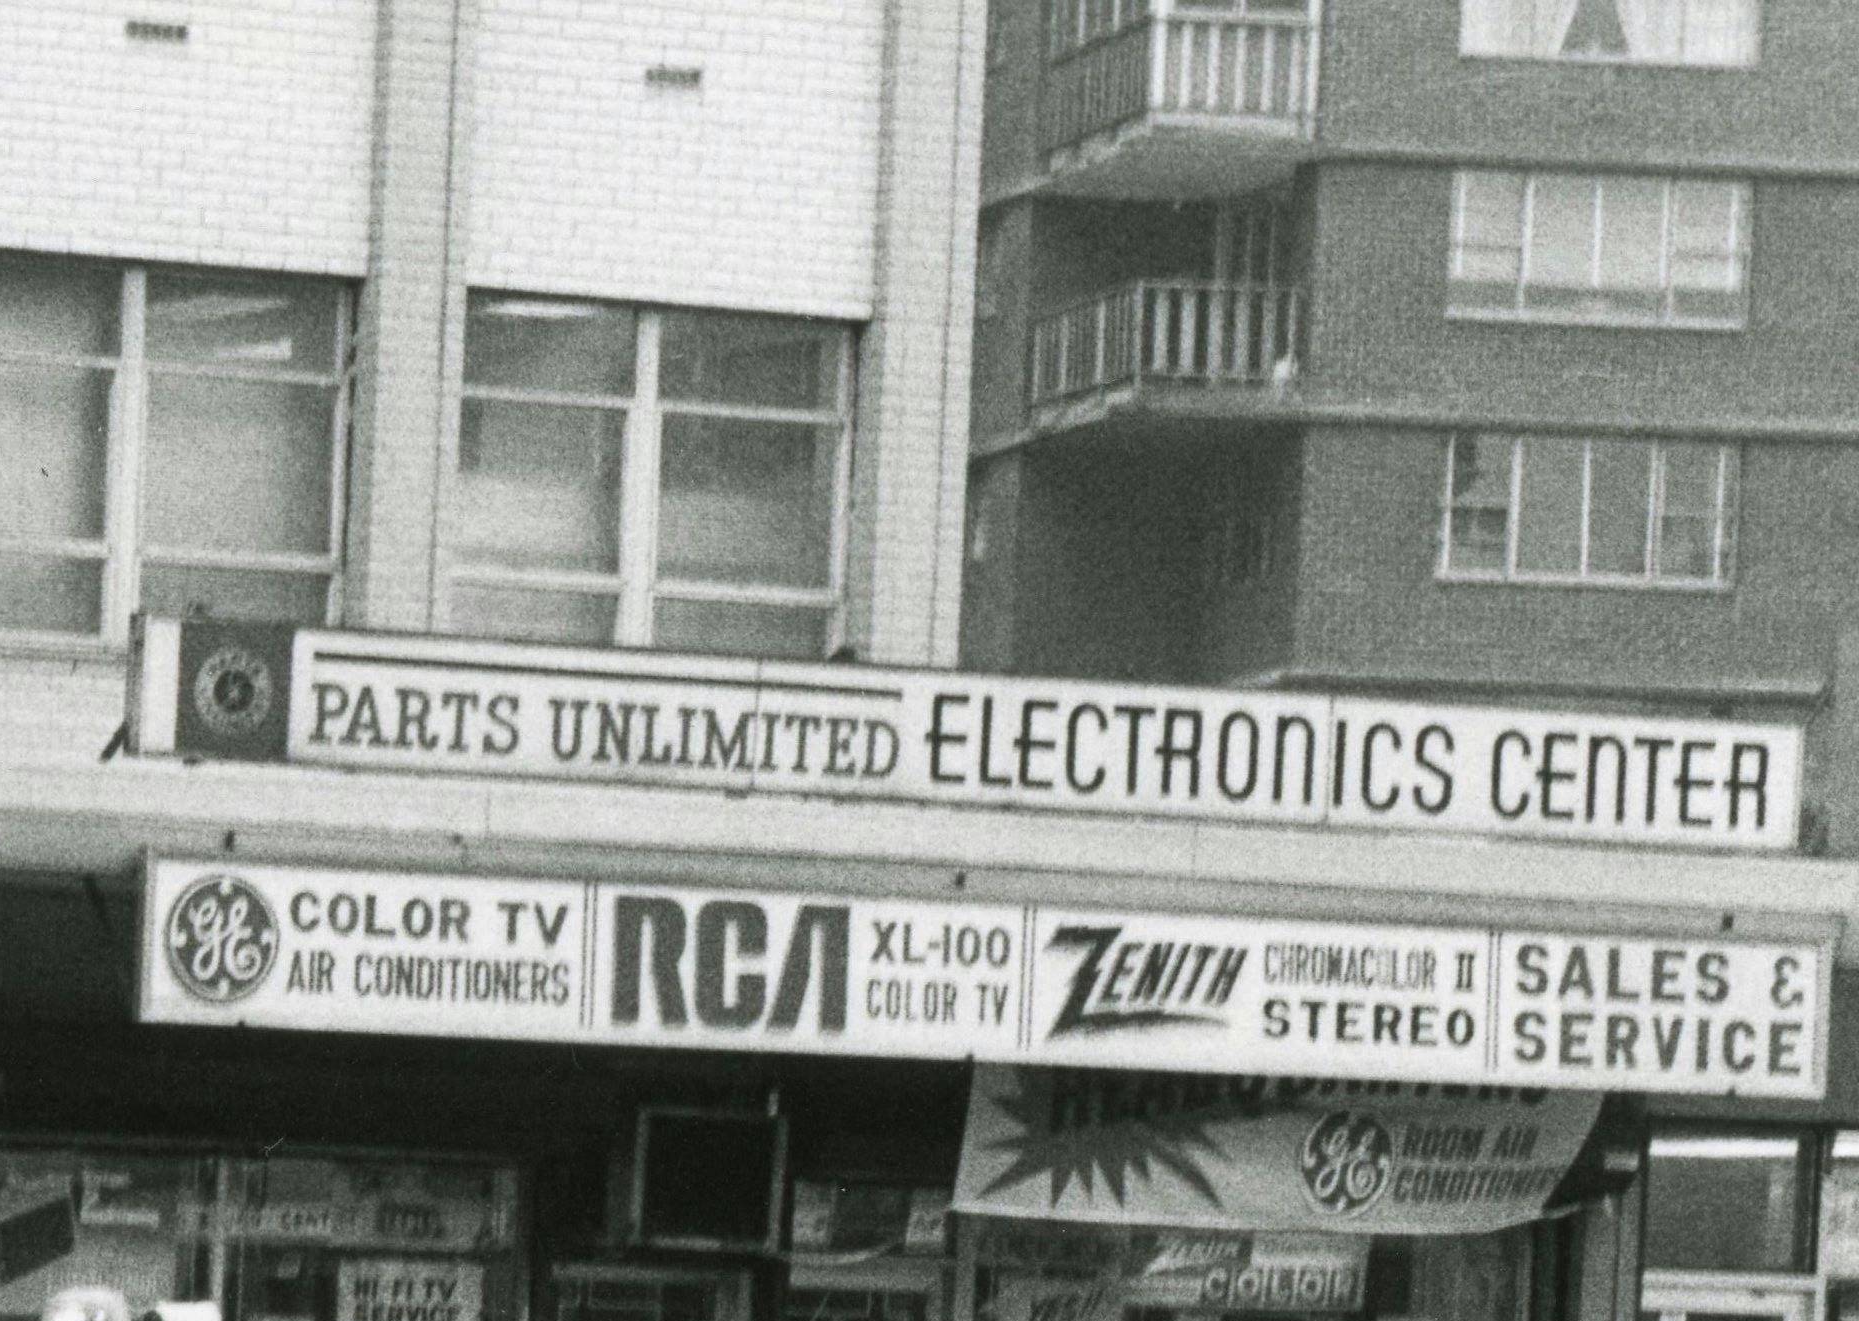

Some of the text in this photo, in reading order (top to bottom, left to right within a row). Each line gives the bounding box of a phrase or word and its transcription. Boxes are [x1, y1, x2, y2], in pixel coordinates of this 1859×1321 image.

[306, 682, 521, 755] PARTS
[547, 698, 902, 779] UNLIMITED
[925, 690, 1456, 815] ELECTRONICS
[1490, 729, 1772, 831] CENTER
[289, 892, 570, 946] COLOR TV
[870, 920, 1011, 968] XL-100
[285, 951, 570, 1006] AIR CONDITIONERS
[613, 894, 852, 1031] RCA
[1043, 924, 1250, 1040] ZENITH
[1264, 943, 1476, 992] CHROMACOLOR II
[1515, 943, 1805, 1010] SALES &
[866, 977, 1009, 1026] COLOR TV
[1263, 997, 1475, 1046] STEREO
[1513, 1012, 1804, 1078] SERVICE
